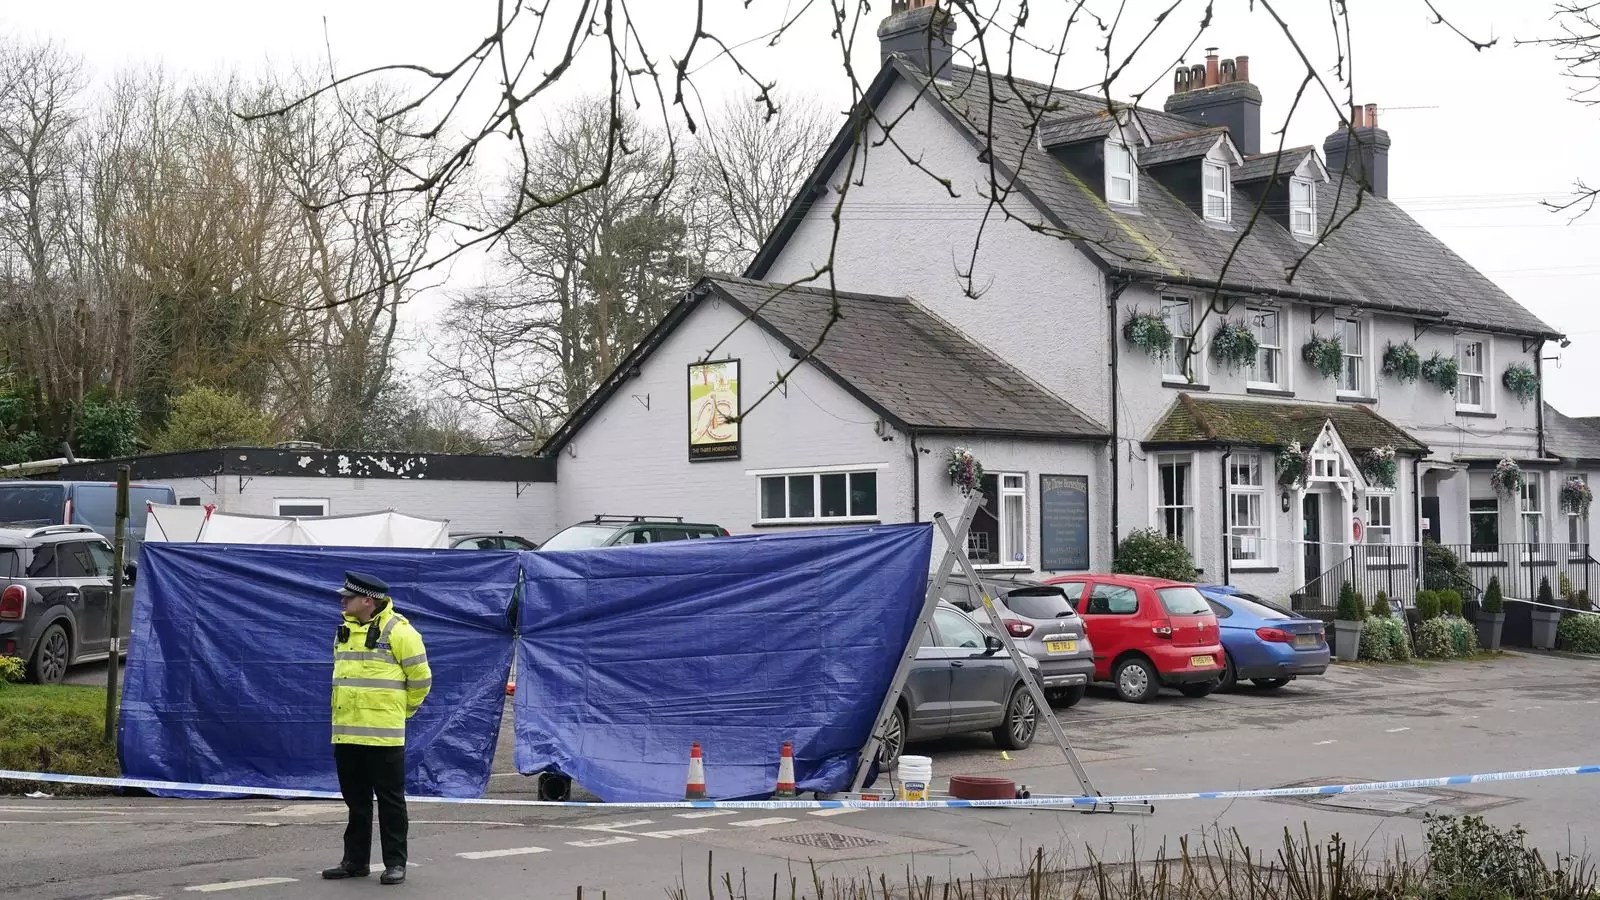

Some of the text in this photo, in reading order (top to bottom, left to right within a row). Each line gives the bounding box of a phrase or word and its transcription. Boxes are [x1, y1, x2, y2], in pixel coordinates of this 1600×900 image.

[1042, 478, 1086, 495] The Three Horseshoes
